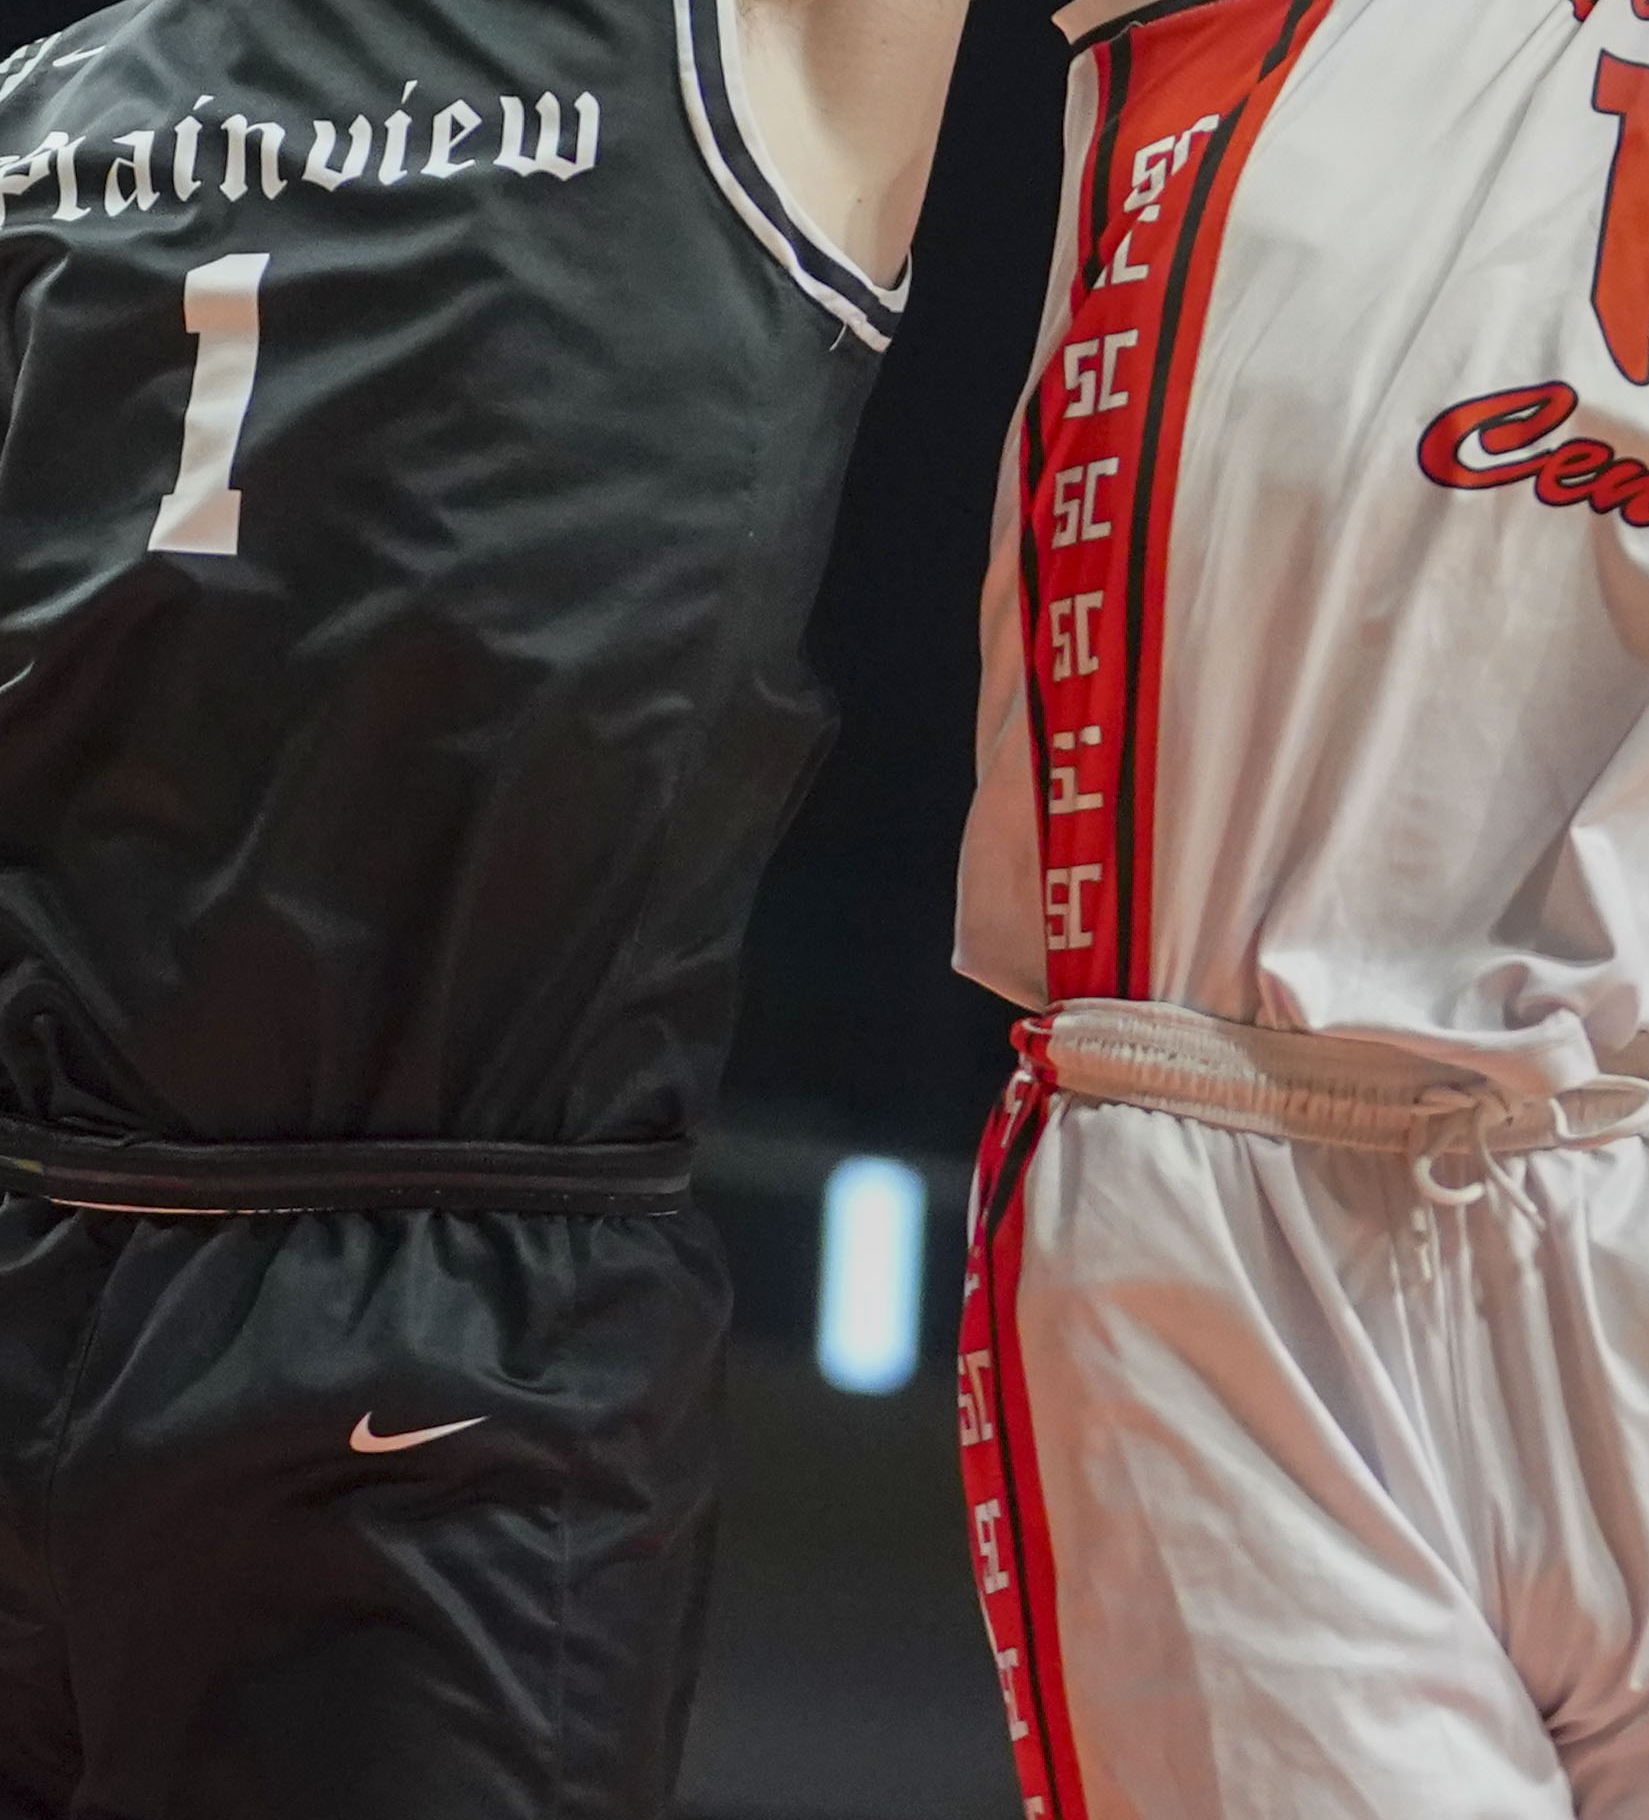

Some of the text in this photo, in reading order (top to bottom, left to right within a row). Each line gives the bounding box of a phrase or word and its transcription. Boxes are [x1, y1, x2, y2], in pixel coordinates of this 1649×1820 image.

[148, 253, 270, 555] 1
[1063, 329, 1139, 420] SC
[1052, 456, 1119, 550] SC
[1048, 590, 1104, 682] SC
